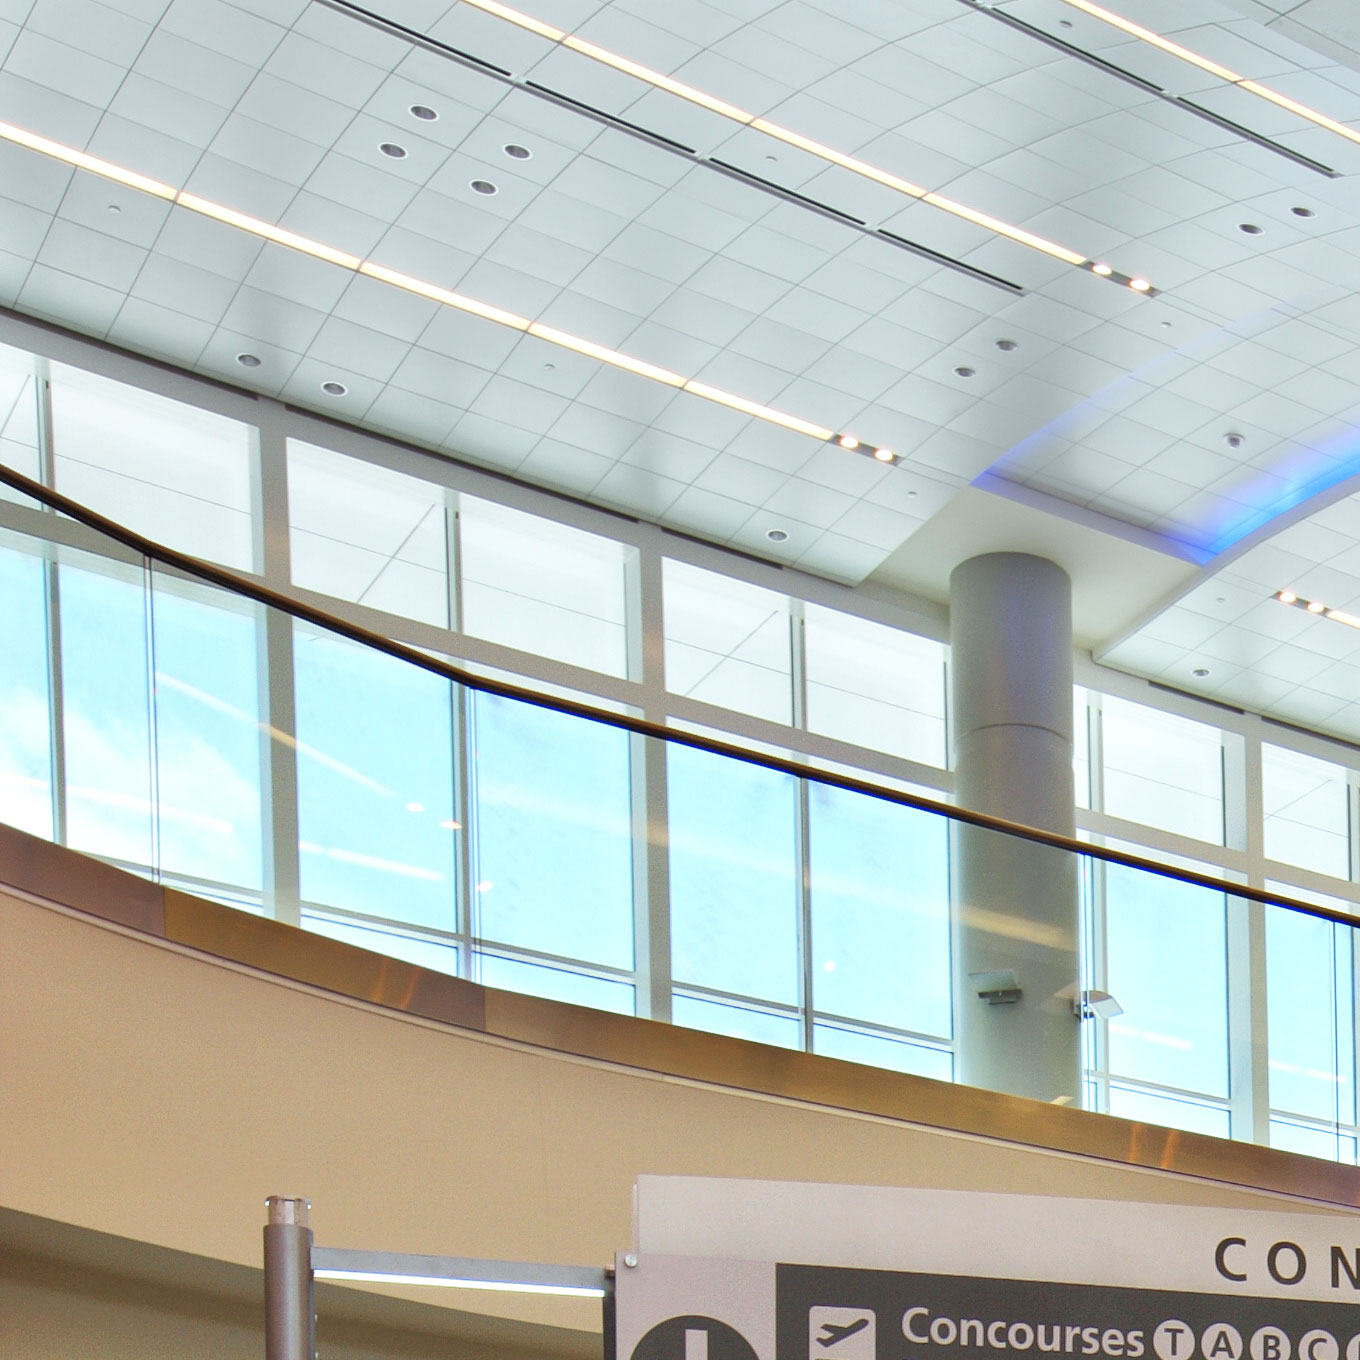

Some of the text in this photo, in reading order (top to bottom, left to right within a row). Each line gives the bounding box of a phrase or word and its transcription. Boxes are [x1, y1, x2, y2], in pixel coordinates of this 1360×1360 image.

[902, 1307, 1145, 1357] Concourses
[1163, 1327, 1185, 1357] T
[1209, 1330, 1236, 1359] A
